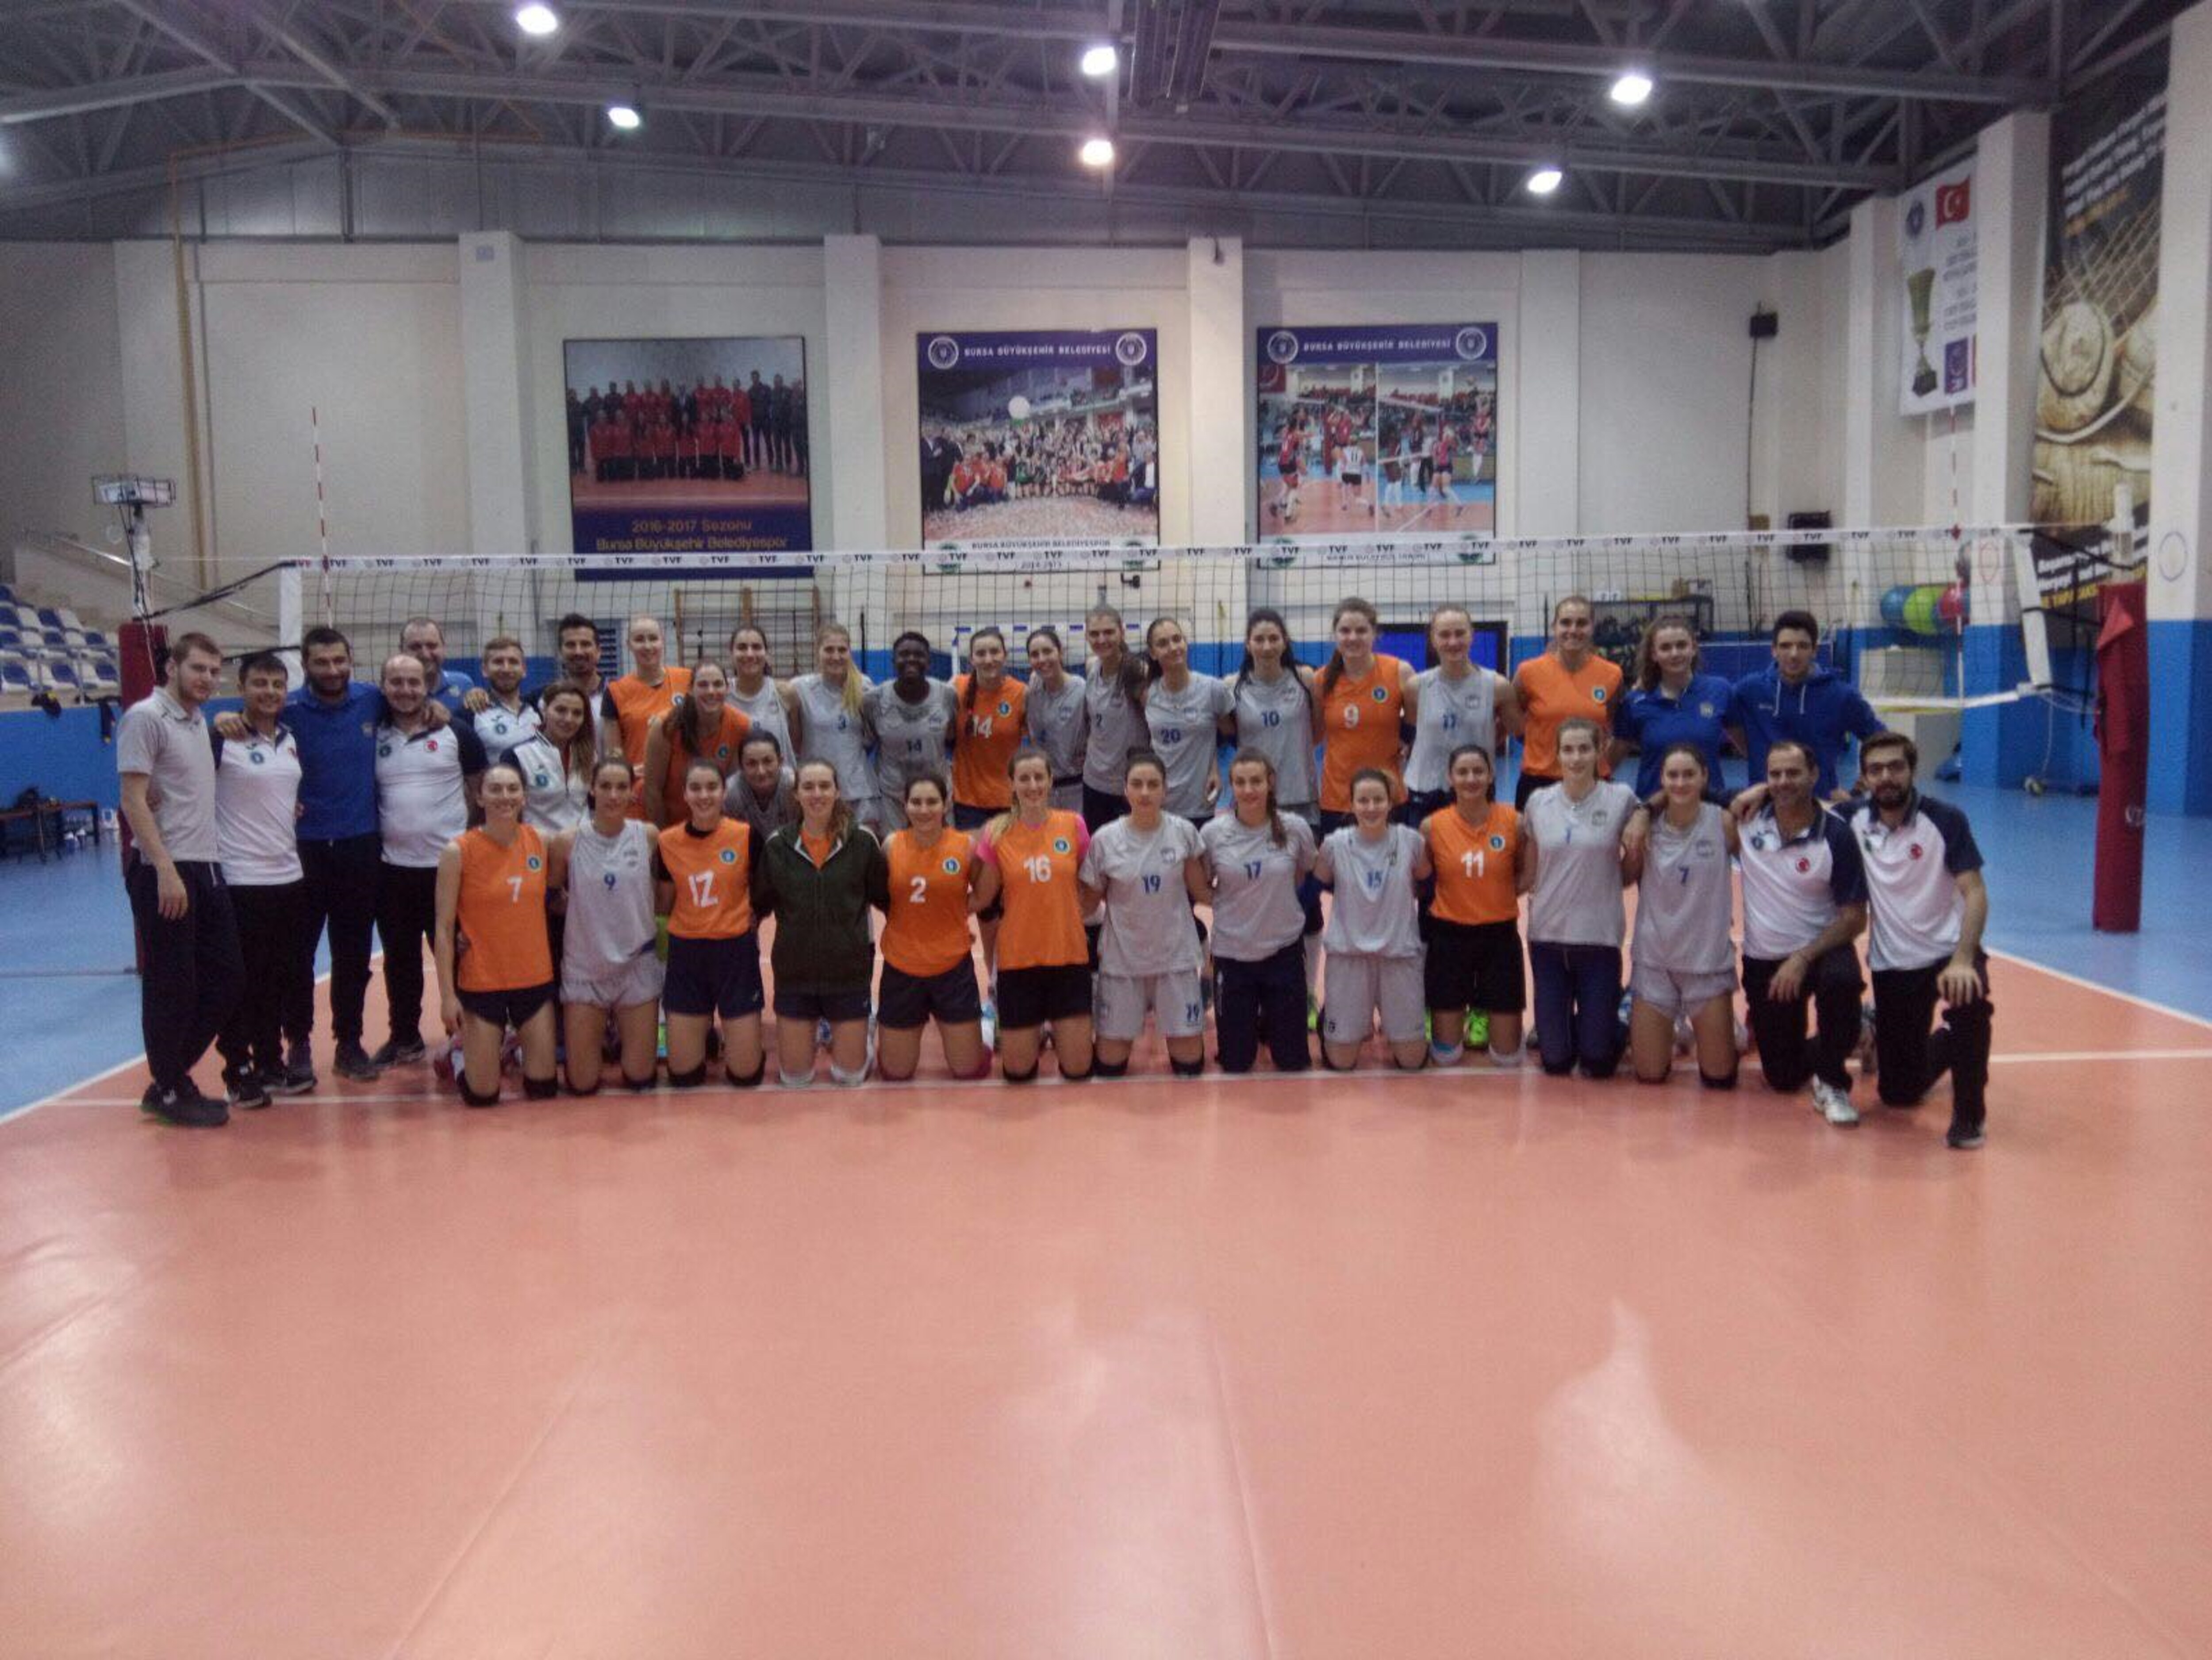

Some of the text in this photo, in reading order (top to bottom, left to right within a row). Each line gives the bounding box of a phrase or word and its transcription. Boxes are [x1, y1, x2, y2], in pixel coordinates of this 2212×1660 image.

[964, 347, 994, 357] BURSA
[703, 520, 753, 532] Sezonu
[597, 538, 632, 550] Bursa
[1262, 711, 1280, 726] 10
[1344, 703, 1359, 728] 9
[973, 715, 993, 738] 14
[1160, 728, 1181, 745] 20
[1024, 856, 1052, 883] 16
[1244, 861, 1261, 879] 17
[1461, 852, 1484, 877] 11
[604, 873, 616, 891] 9
[1679, 865, 1690, 884] 7
[507, 876, 522, 903] 7
[688, 870, 718, 908] 12
[910, 876, 927, 903] 2
[1142, 875, 1161, 894] 19
